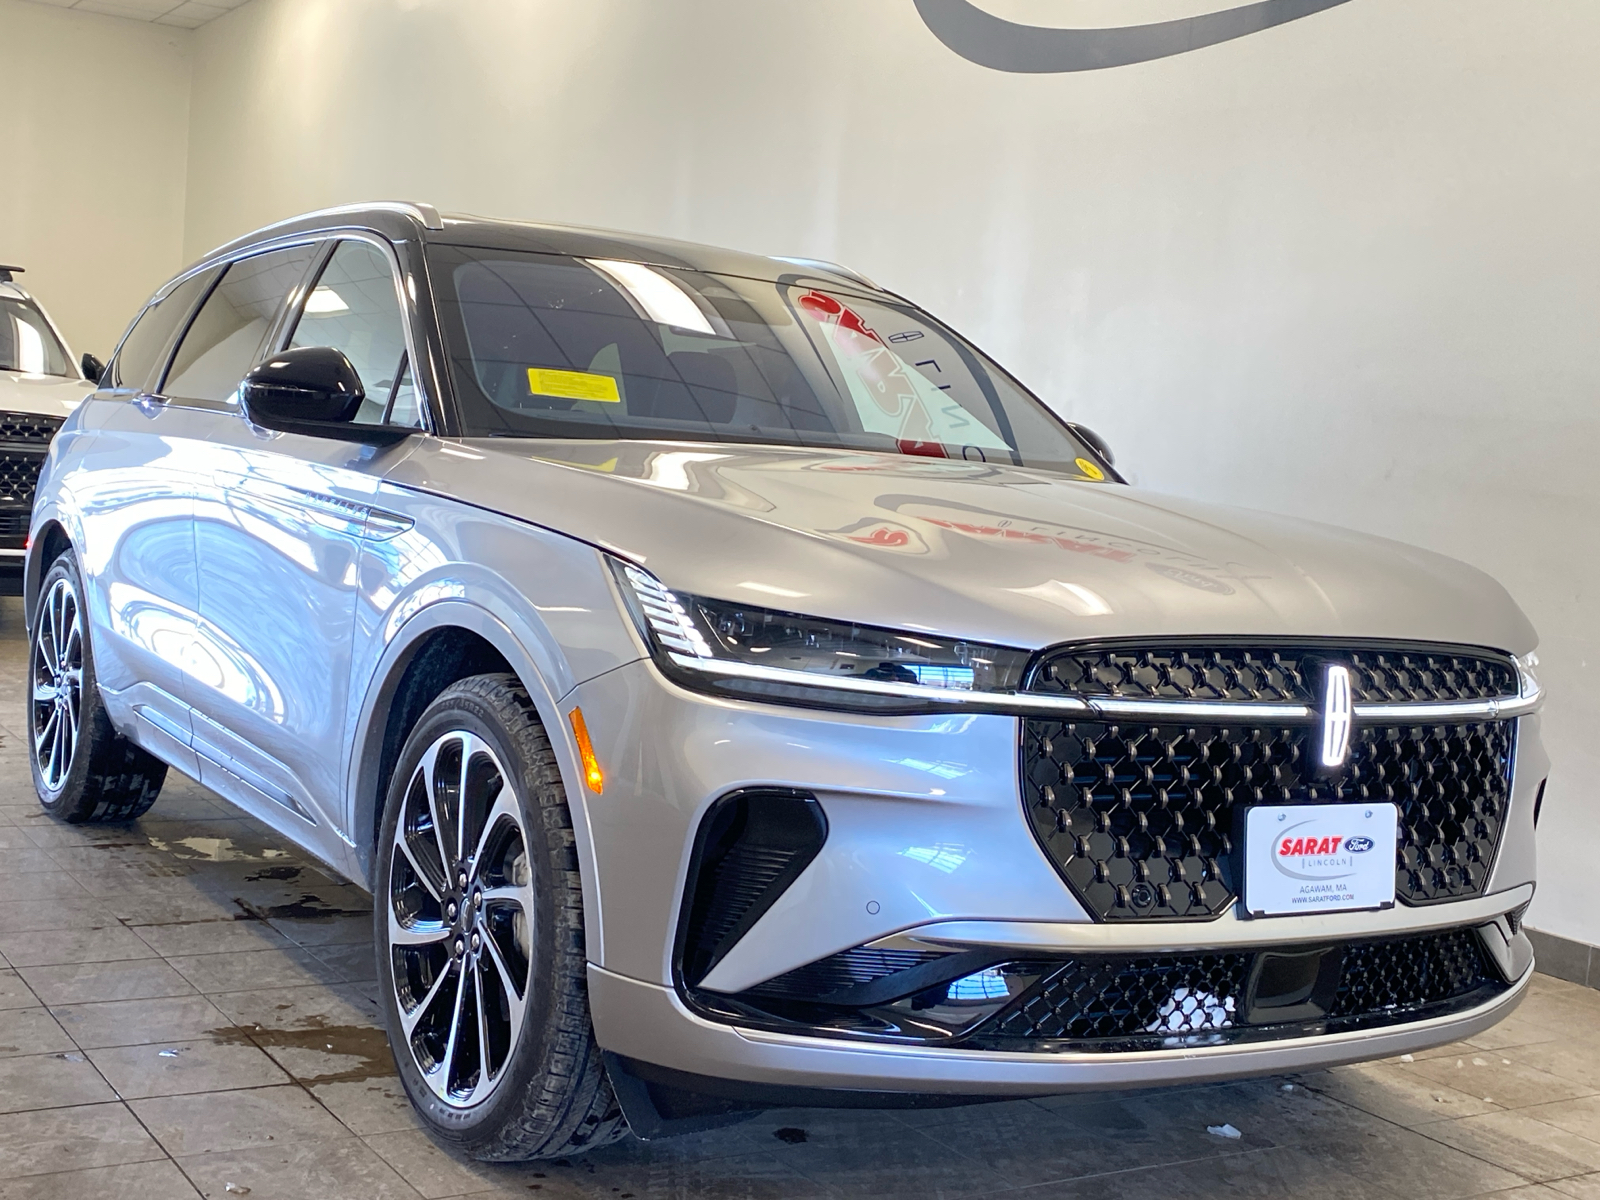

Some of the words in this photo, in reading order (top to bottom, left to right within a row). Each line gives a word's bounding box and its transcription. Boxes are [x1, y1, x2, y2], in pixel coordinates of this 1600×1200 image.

[1278, 836, 1343, 857] SARAT
[1348, 838, 1370, 851] Ford
[1308, 858, 1347, 867] LINCOLN
[1299, 885, 1335, 894] AGAWAM,
[1336, 884, 1347, 892] MA
[1291, 894, 1355, 904] WWW.SARATFORD.COM
